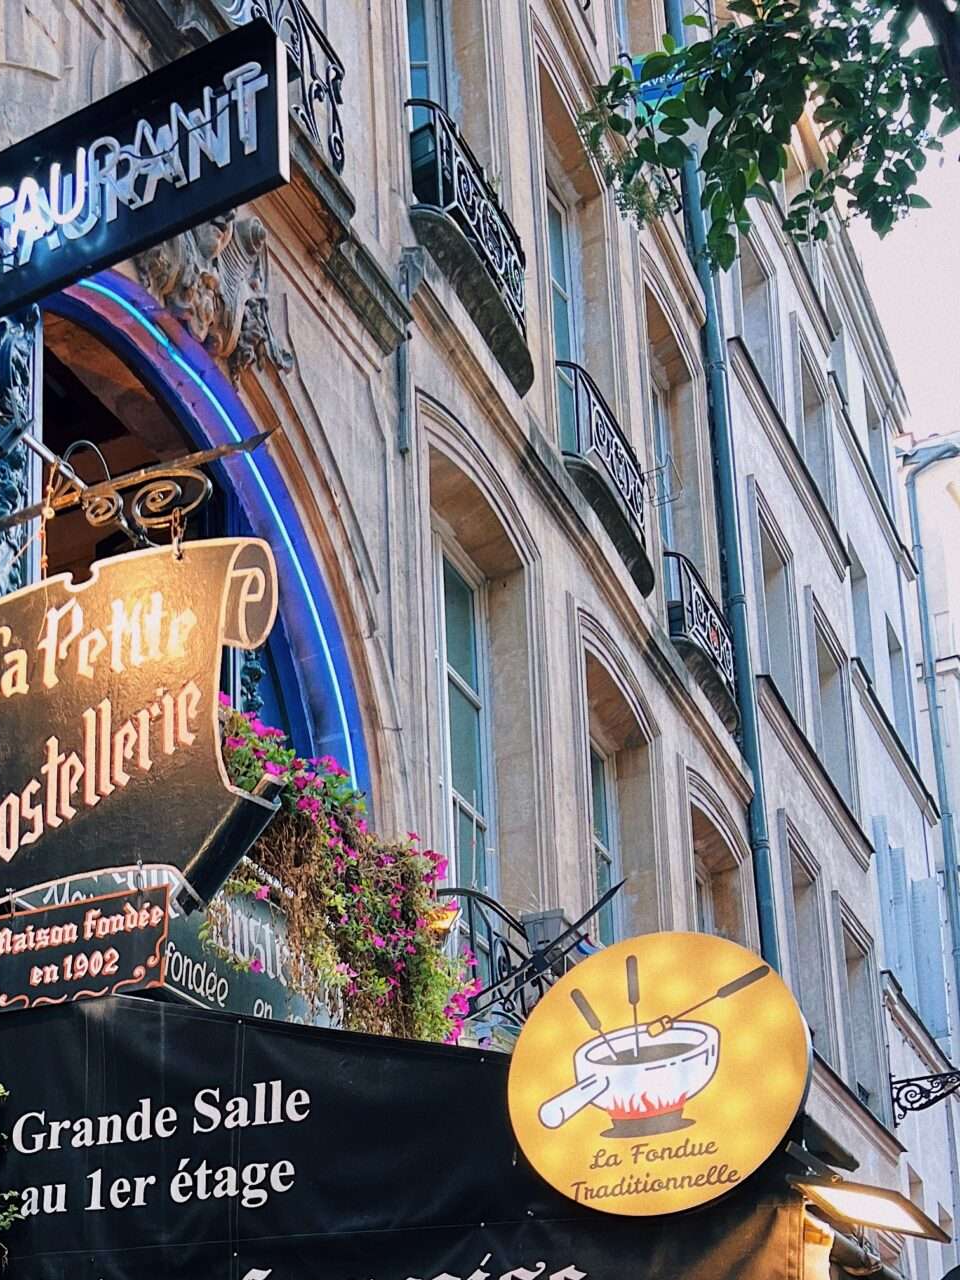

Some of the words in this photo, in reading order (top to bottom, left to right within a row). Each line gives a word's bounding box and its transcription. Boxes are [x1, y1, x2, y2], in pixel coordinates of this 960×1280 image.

[38, 591, 197, 688] Petite
[83, 902, 164, 940] Fondée
[29, 964, 59, 987] en
[62, 946, 120, 981] 1902
[164, 942, 229, 1008] fondée
[12, 1099, 178, 1156] Grande
[192, 1079, 312, 1135] Salle
[590, 1149, 621, 1170] La
[631, 1138, 719, 1165] Fondue
[21, 1183, 66, 1217] au
[86, 1168, 155, 1213] 1er
[169, 1160, 296, 1209] étage
[570, 1165, 741, 1201] Traditionnelle
